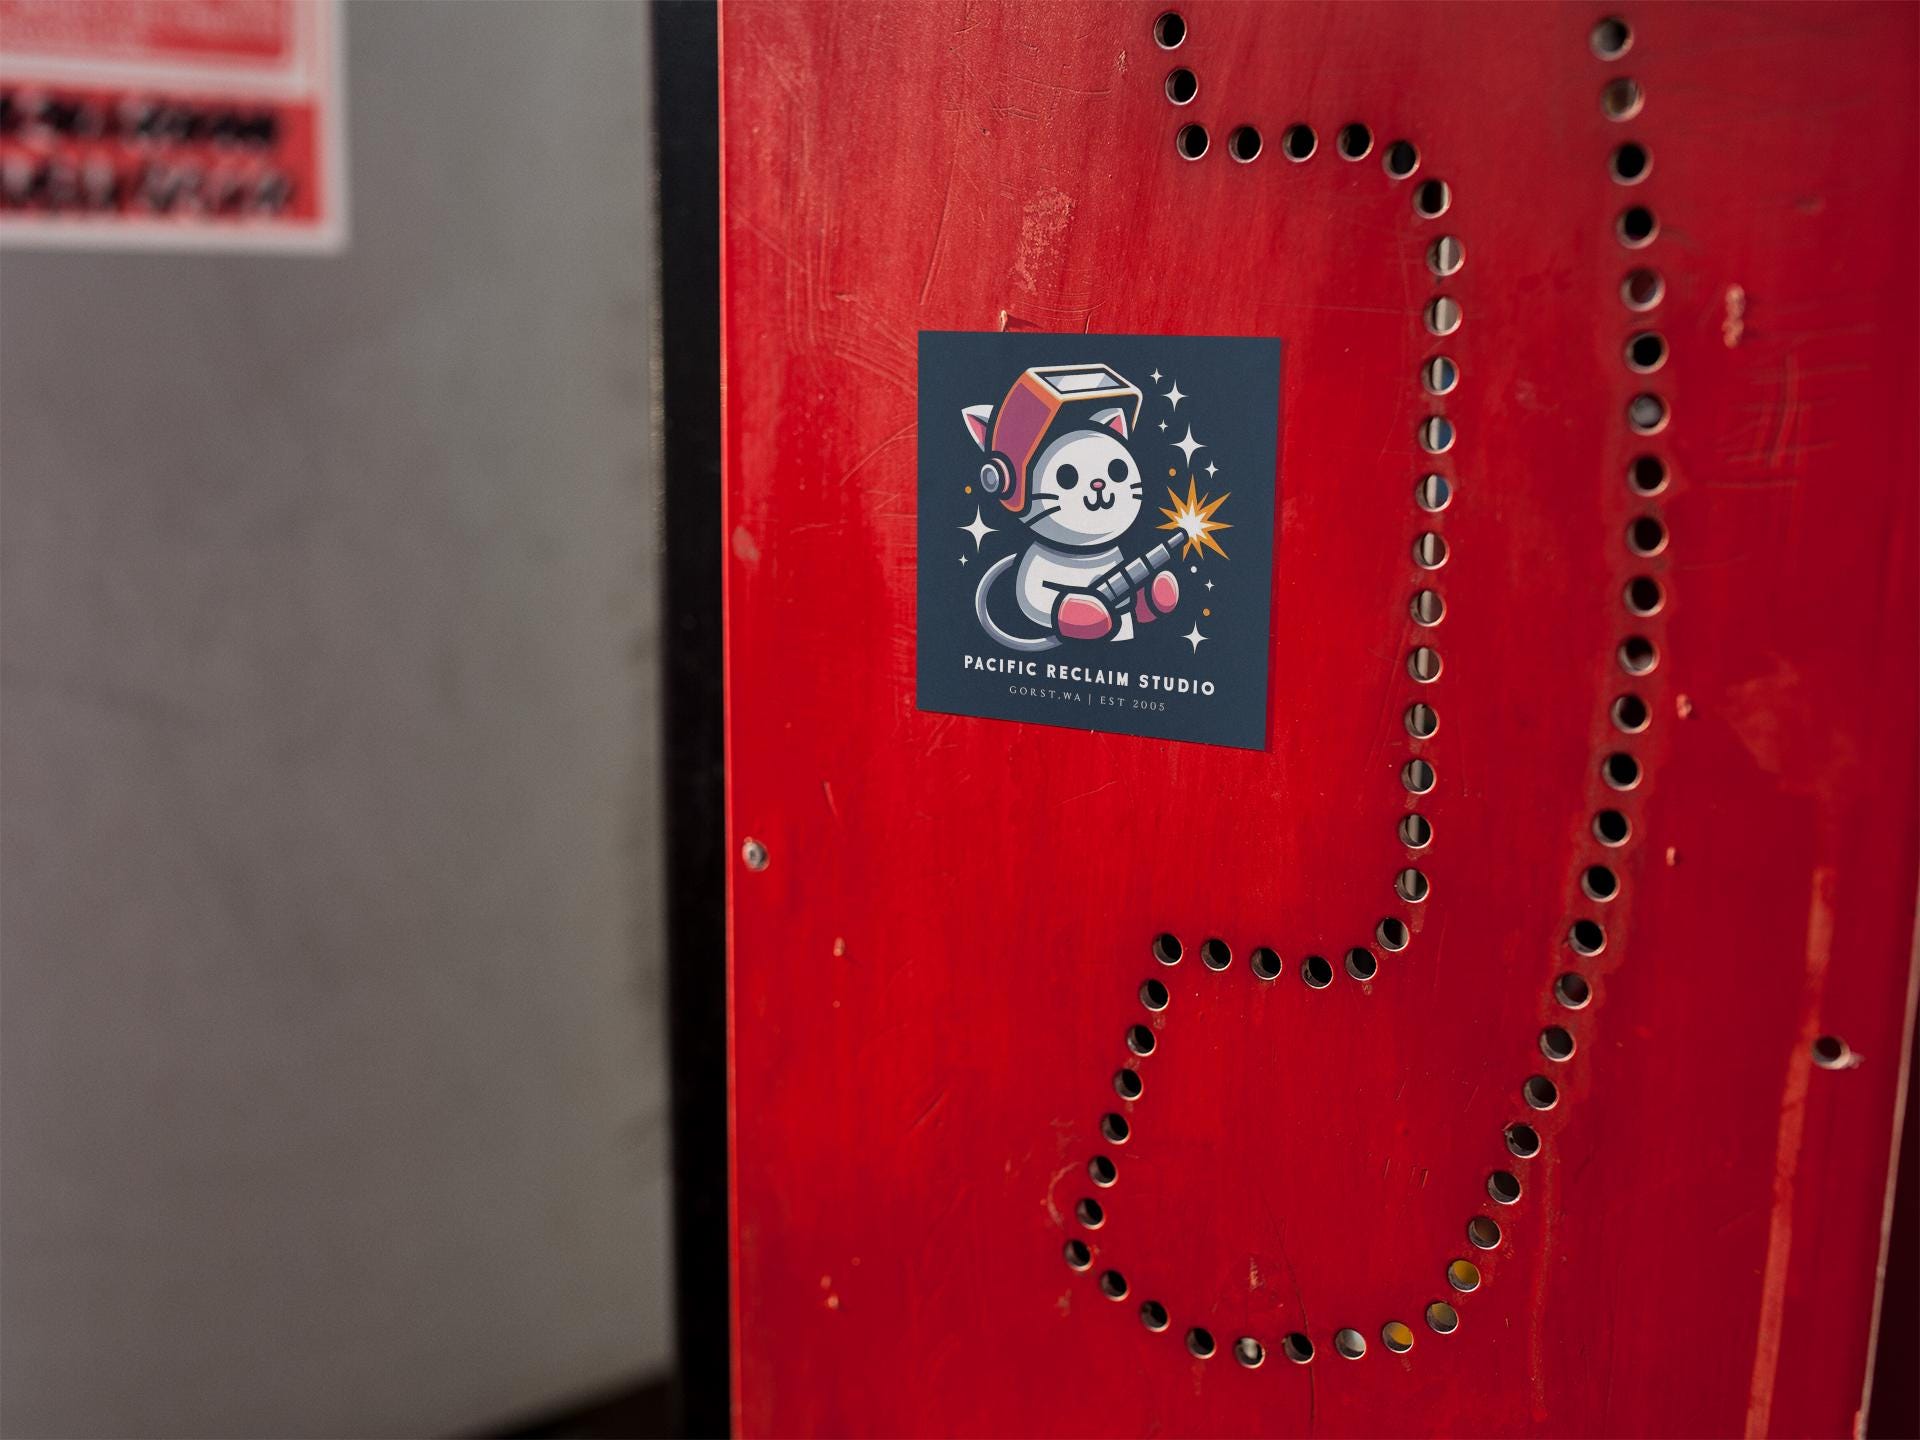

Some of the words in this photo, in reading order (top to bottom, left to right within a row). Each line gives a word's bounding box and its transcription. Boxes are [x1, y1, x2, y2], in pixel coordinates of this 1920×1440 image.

[964, 655, 1037, 676] PACIFIC
[1046, 664, 1129, 686] RECLAIM
[1138, 675, 1215, 696] STUDIO
[1100, 696, 1125, 707] EST
[1132, 699, 1166, 712] 2005
